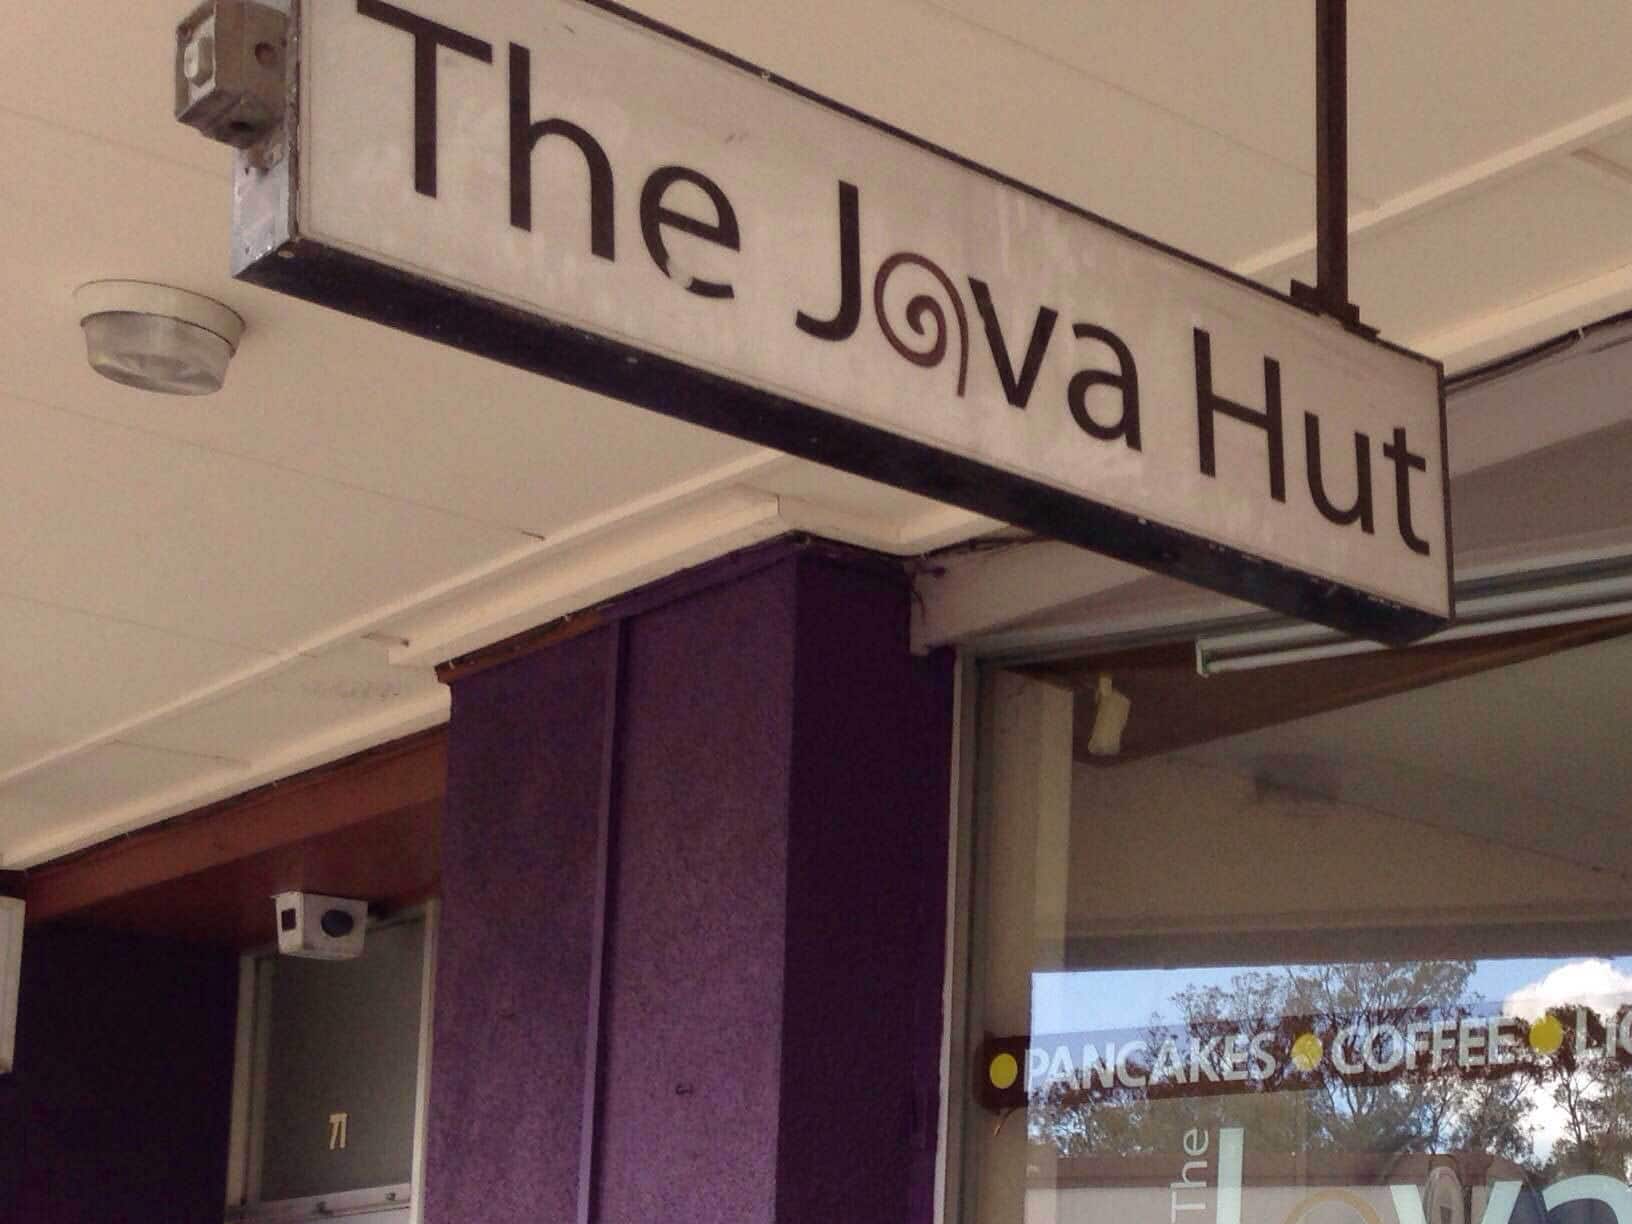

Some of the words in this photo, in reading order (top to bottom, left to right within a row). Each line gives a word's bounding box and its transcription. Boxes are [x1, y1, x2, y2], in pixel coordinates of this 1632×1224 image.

[357, 0, 741, 300] The
[1193, 327, 1431, 557] Hut
[1024, 1031, 1277, 1091] PANCAKES
[1332, 1016, 1519, 1074] COFFEE
[328, 1112, 348, 1150] 71
[1171, 1127, 1209, 1224] The
